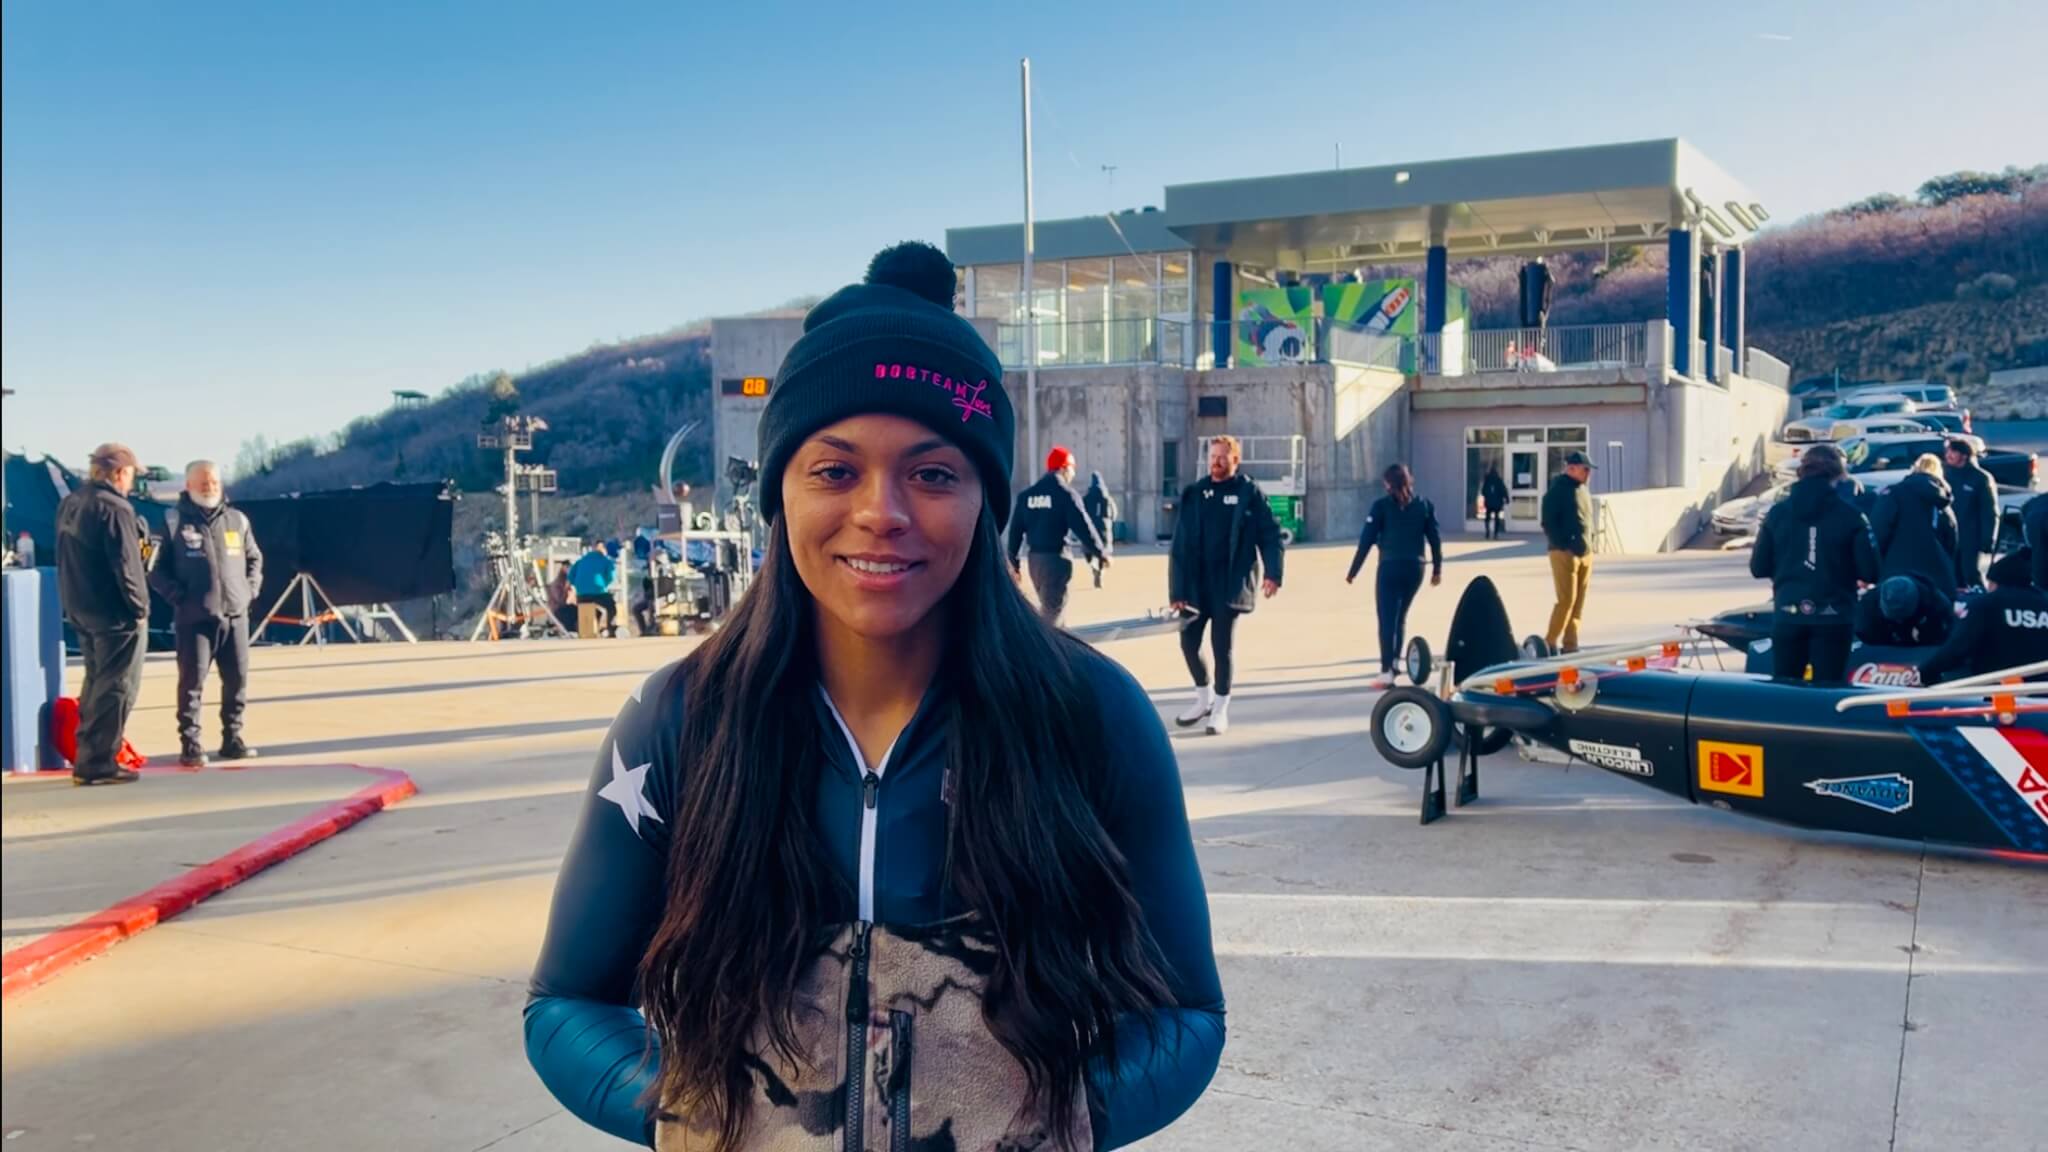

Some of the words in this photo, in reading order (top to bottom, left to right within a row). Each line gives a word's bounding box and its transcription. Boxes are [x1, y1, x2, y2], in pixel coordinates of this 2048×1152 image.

[2004, 608, 2048, 629] USA
[1852, 662, 1922, 688] Cane's
[1585, 752, 1650, 775] LINCOLN
